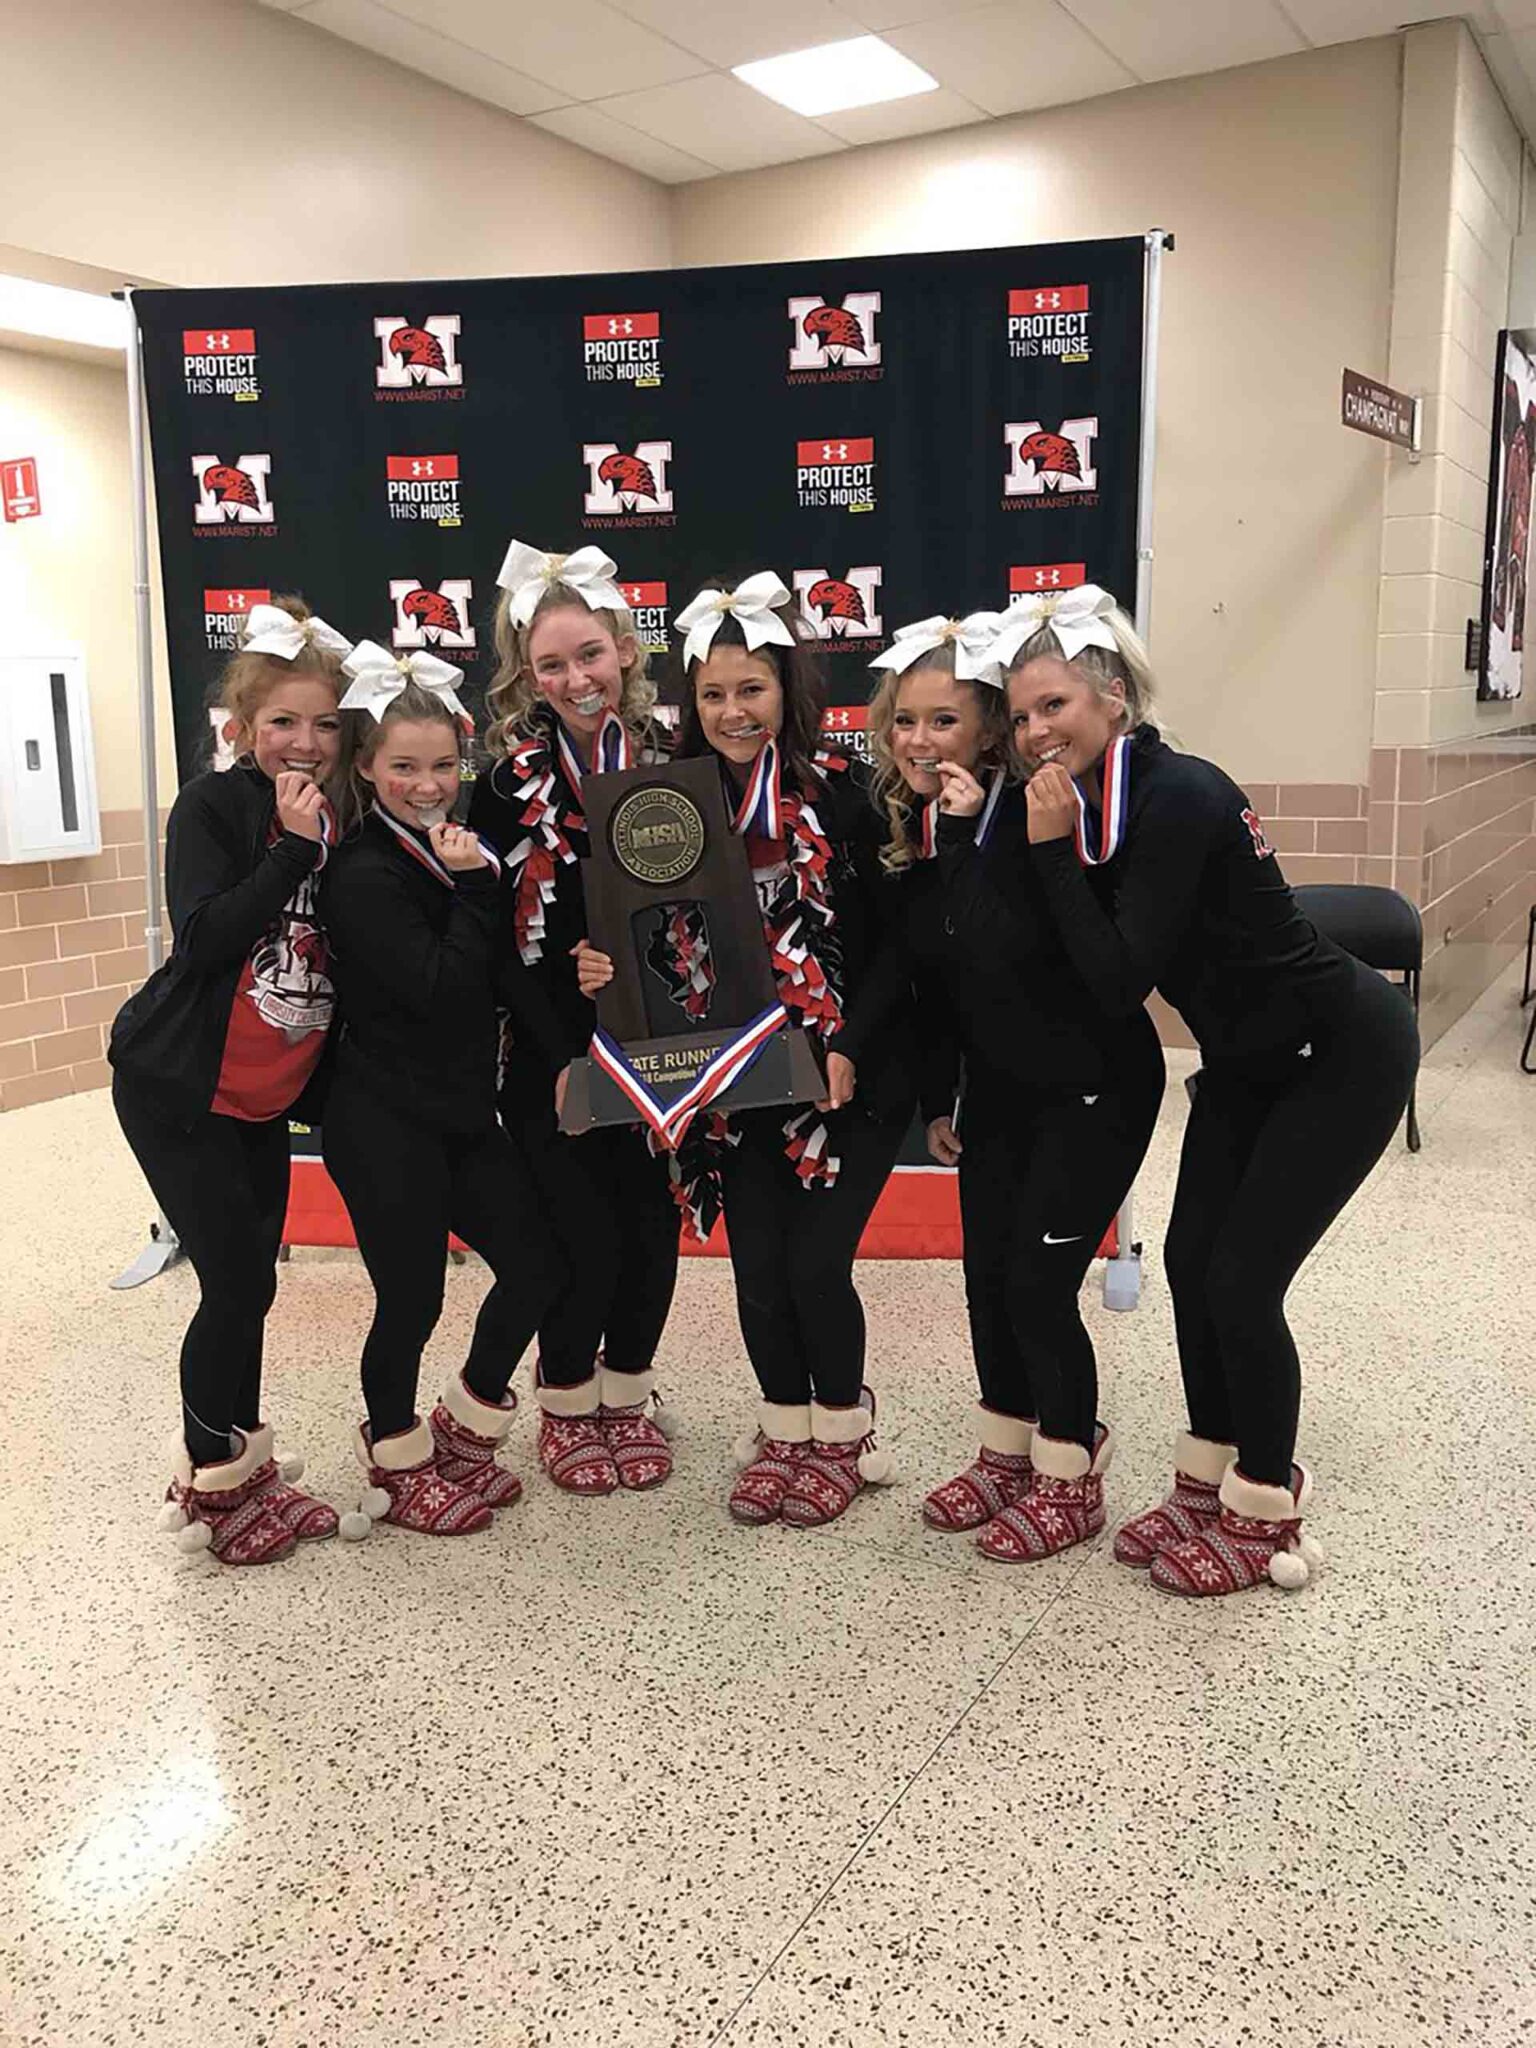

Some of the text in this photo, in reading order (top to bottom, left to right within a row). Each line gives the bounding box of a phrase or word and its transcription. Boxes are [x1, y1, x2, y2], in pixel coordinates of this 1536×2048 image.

[1008, 313, 1088, 338] PROTECT
[584, 339, 659, 363] PROTECT
[1008, 339, 1038, 358] THIS
[184, 355, 256, 377] PROTECT
[585, 365, 614, 381] THIS
[185, 378, 213, 394] THIS
[797, 464, 873, 488] PROTECT
[387, 481, 459, 502] PROTECT
[797, 490, 827, 508] THIS
[388, 504, 417, 519] THIS
[205, 634, 237, 650] THIS
[627, 847, 696, 878] ASSOCIATION
